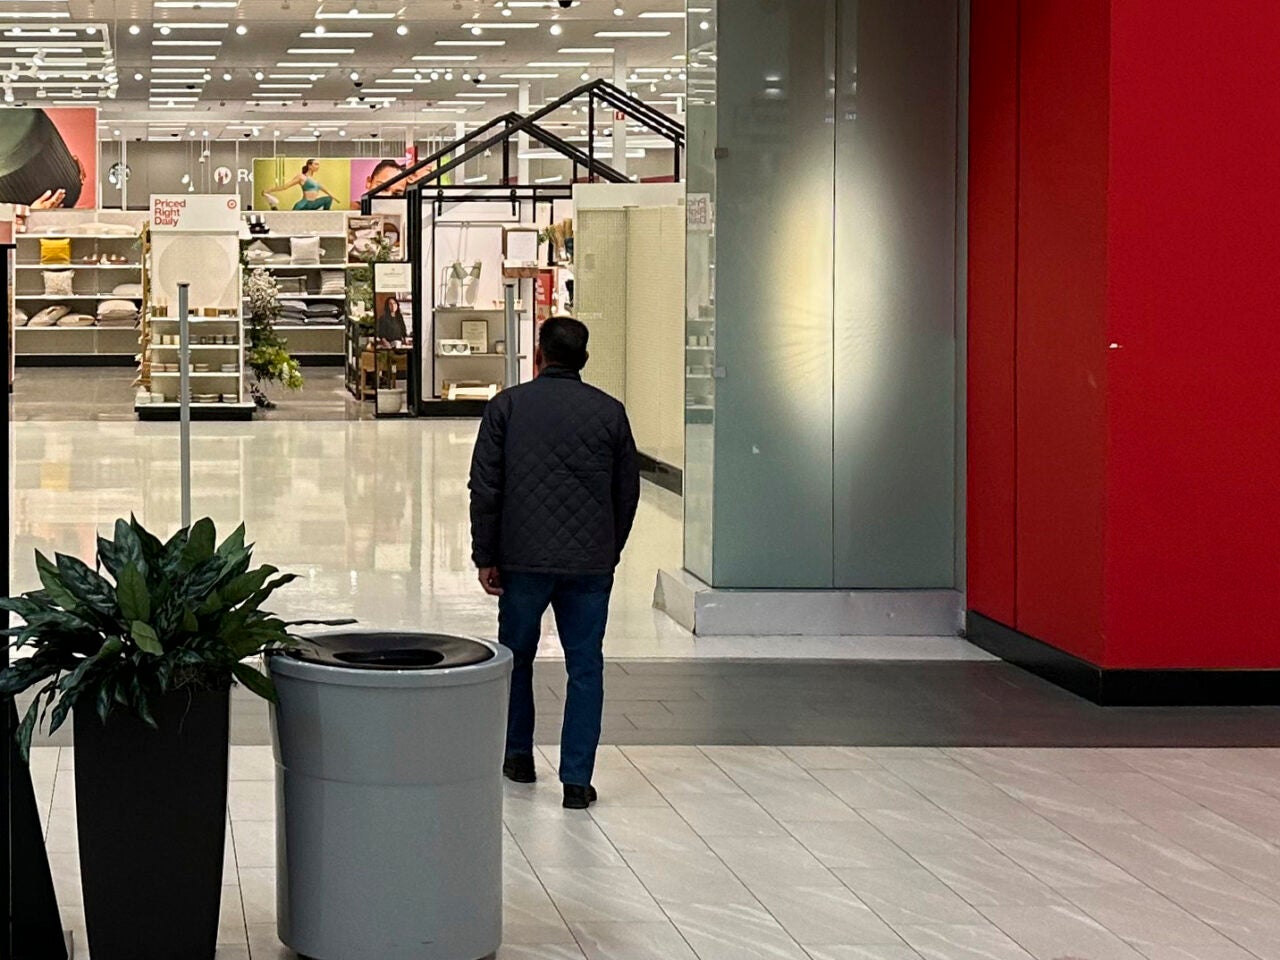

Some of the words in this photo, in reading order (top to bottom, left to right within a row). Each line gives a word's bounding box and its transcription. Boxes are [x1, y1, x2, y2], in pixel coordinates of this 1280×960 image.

[154, 199, 187, 208] Priced
[154, 208, 181, 218] Right
[154, 217, 179, 227] Daily
